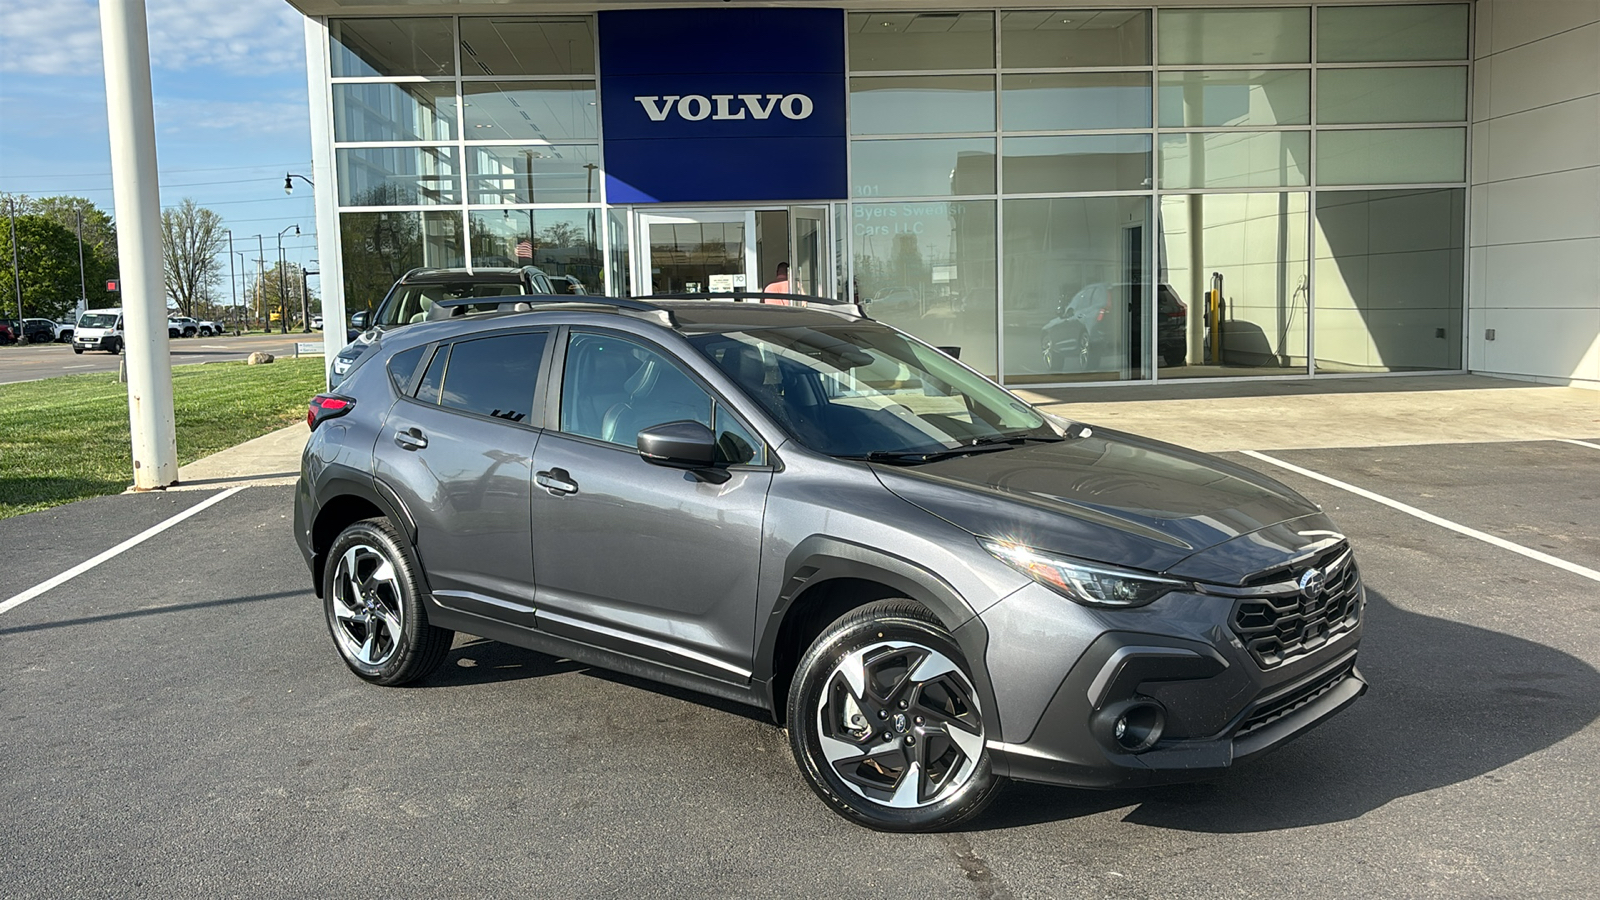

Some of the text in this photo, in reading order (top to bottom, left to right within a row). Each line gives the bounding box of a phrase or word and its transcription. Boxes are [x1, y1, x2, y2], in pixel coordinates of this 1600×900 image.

[634, 94, 813, 121] VOLVO
[855, 185, 879, 196] 301
[854, 206, 897, 220] Byers
[854, 222, 924, 235] Cars LLC
